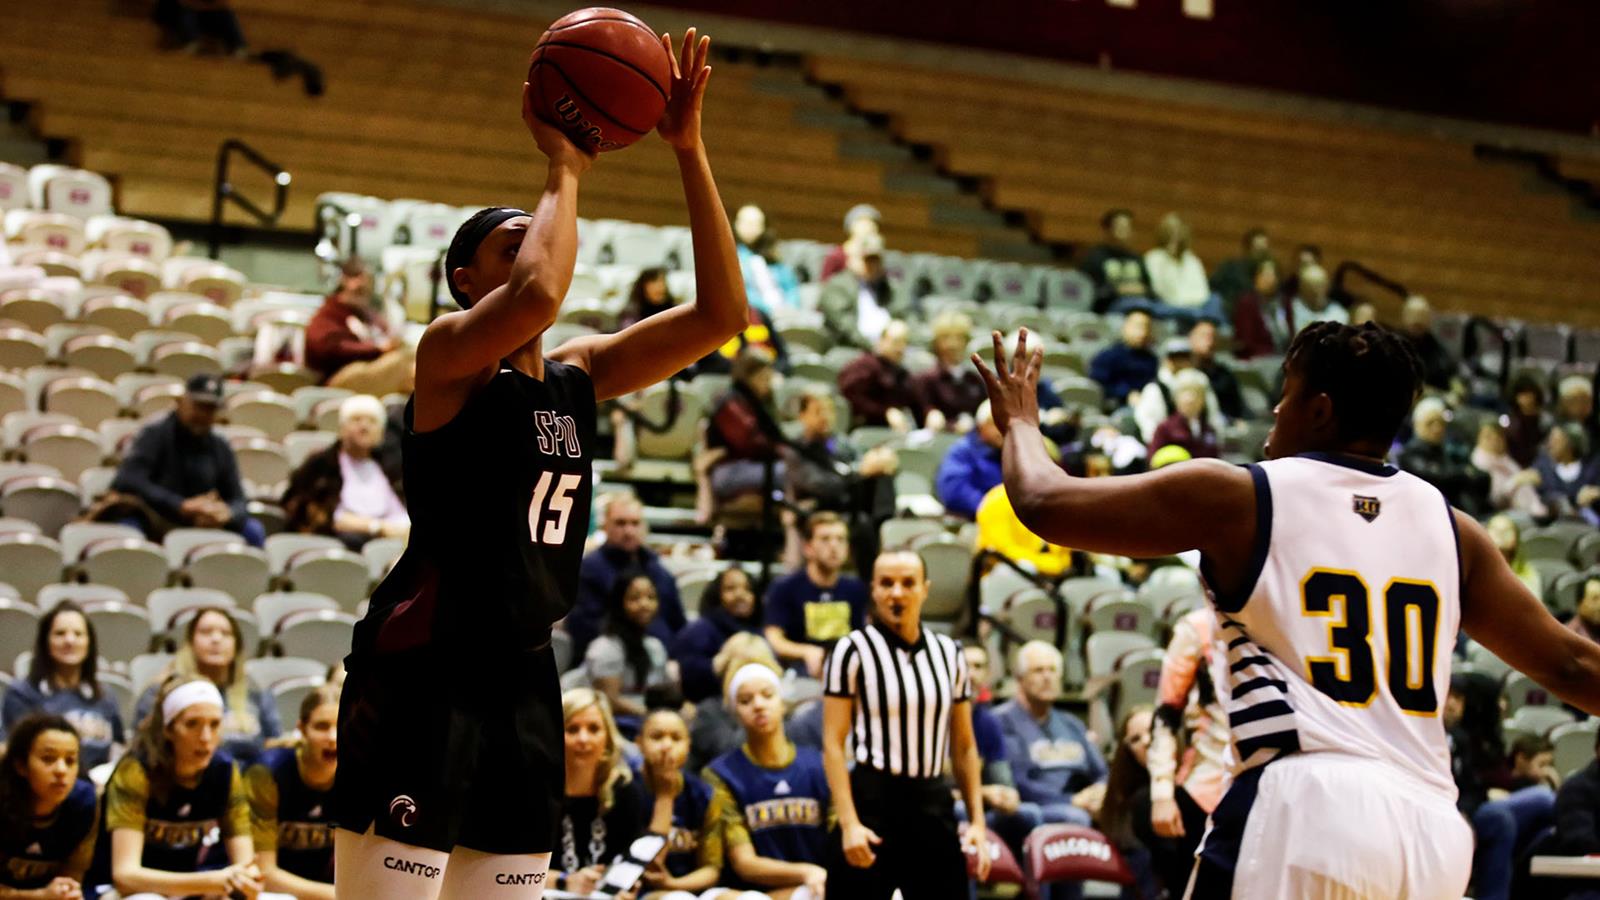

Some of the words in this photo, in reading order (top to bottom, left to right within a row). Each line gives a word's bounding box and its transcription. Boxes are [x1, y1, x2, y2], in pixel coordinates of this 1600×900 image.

[553, 94, 618, 150] Wils
[528, 470, 582, 545] 15
[1299, 566, 1440, 718] 30
